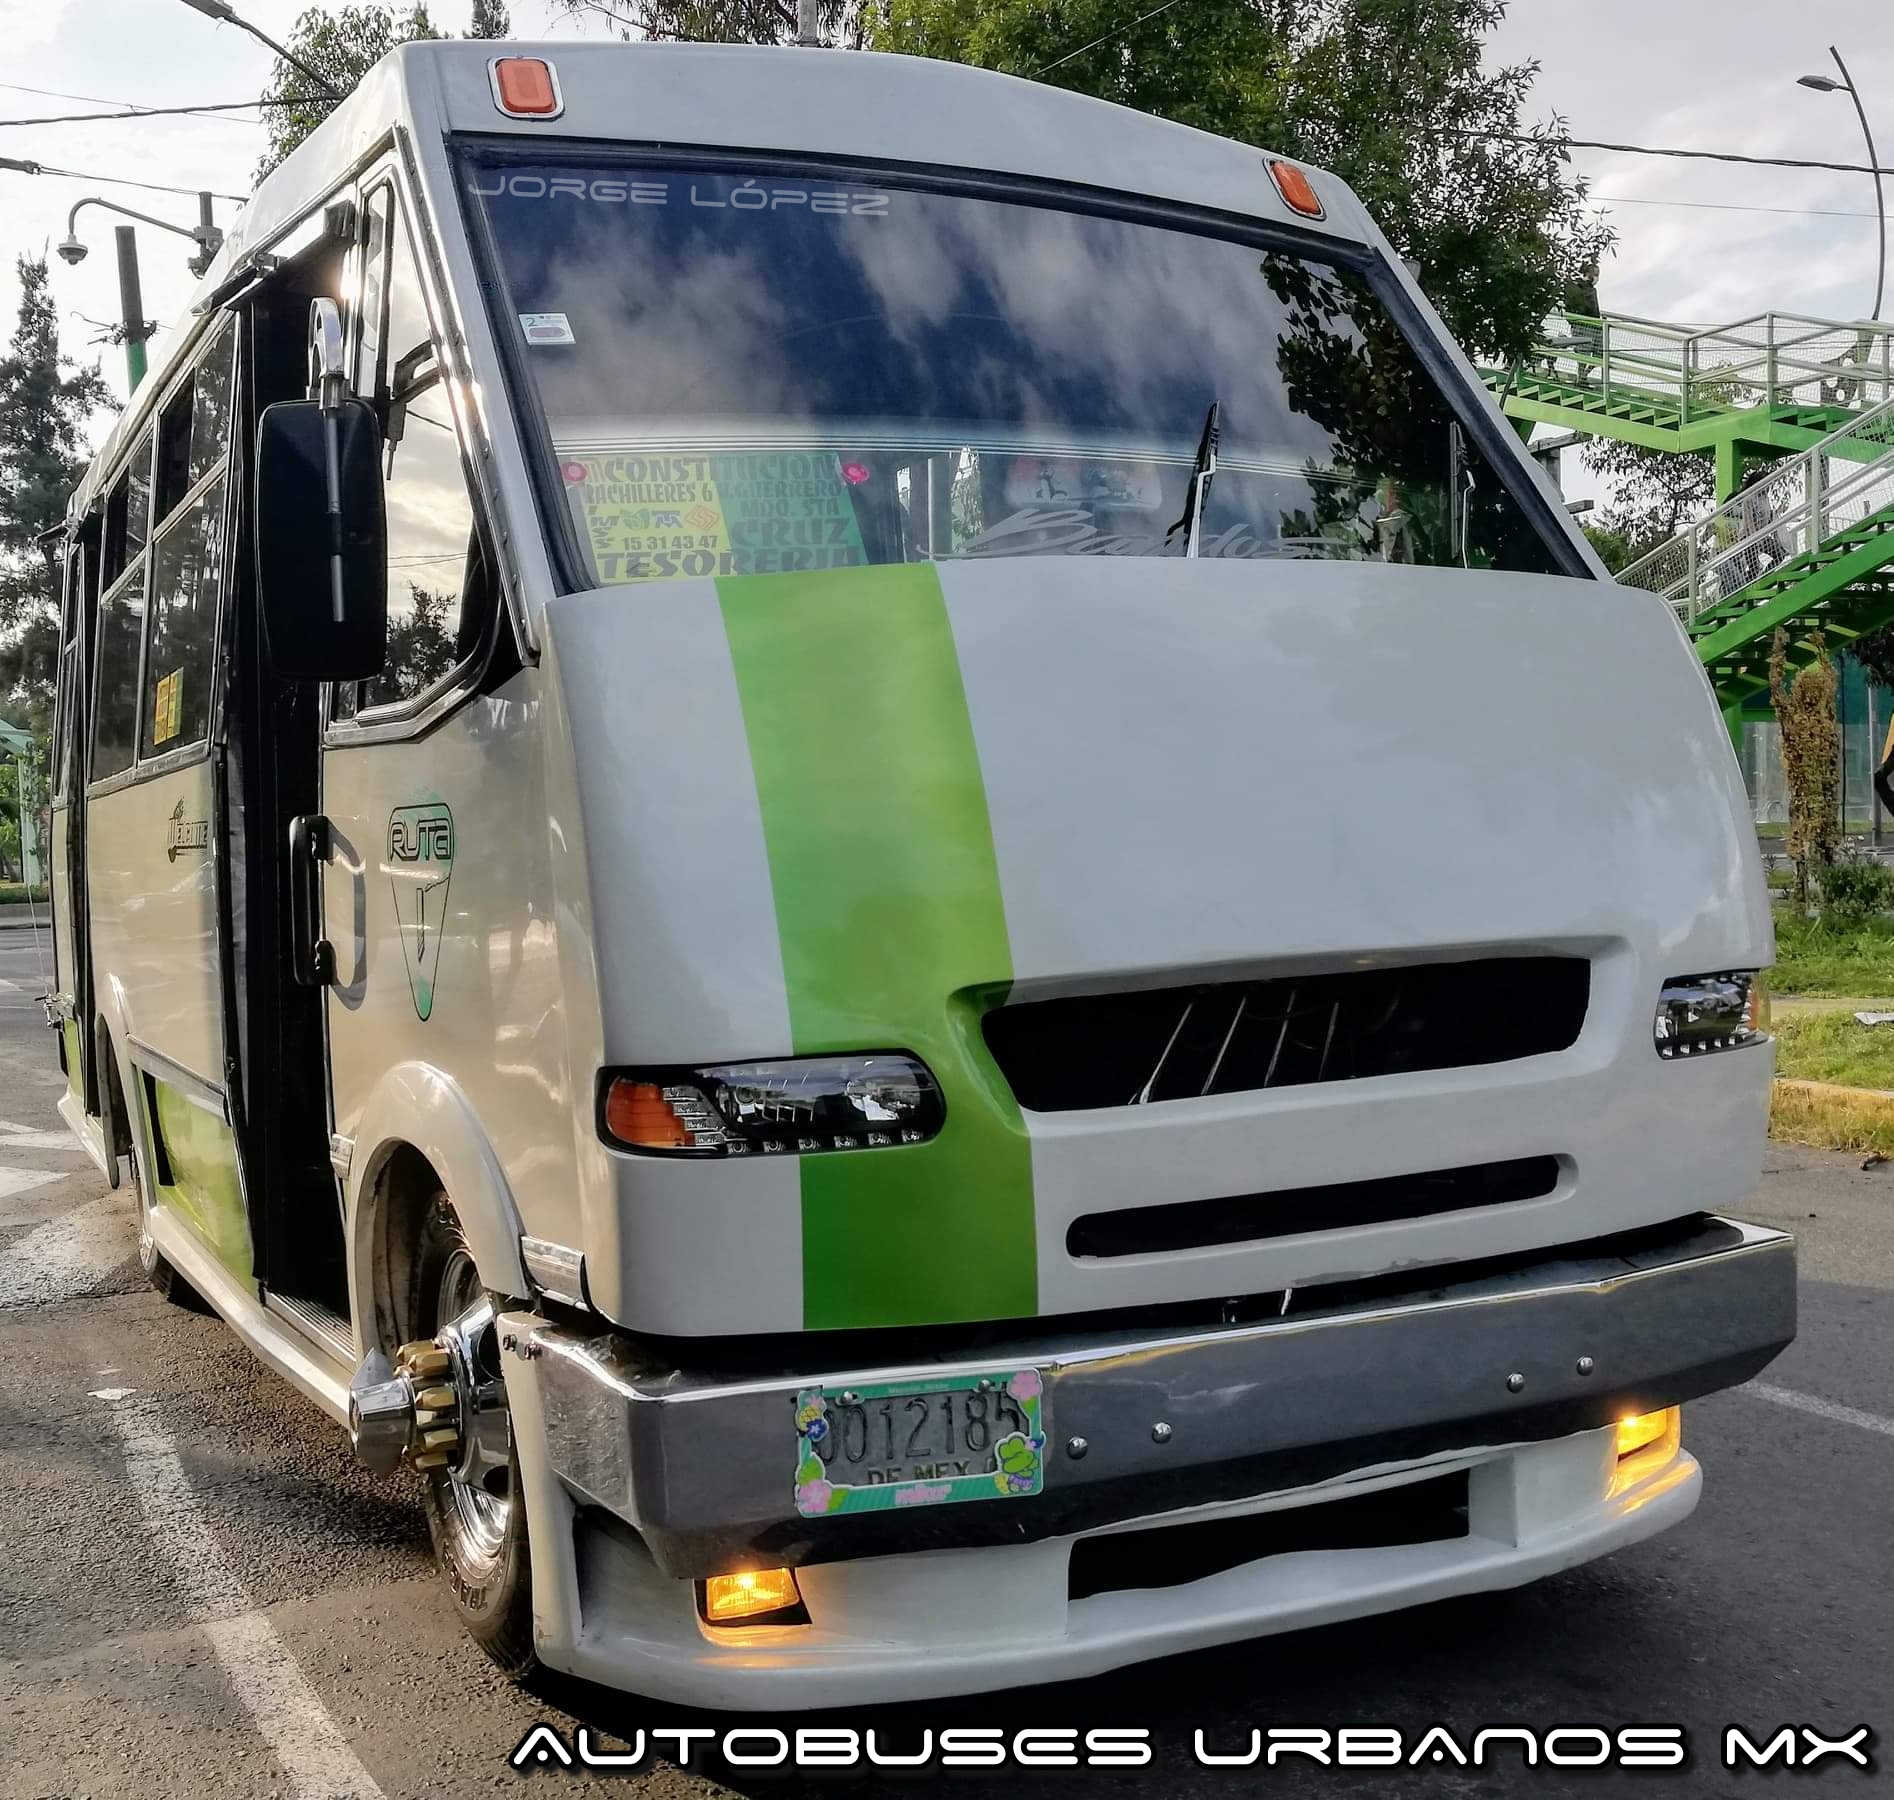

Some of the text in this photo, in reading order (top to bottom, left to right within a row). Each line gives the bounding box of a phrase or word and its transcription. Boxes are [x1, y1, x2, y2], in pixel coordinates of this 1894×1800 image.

[468, 174, 889, 217] JORGE LÓPEZ
[701, 482, 713, 502] 6
[804, 499, 839, 516] STA
[622, 535, 718, 550] 15 31 43 47
[732, 518, 850, 547] CRUZ
[390, 818, 451, 861] RUTA
